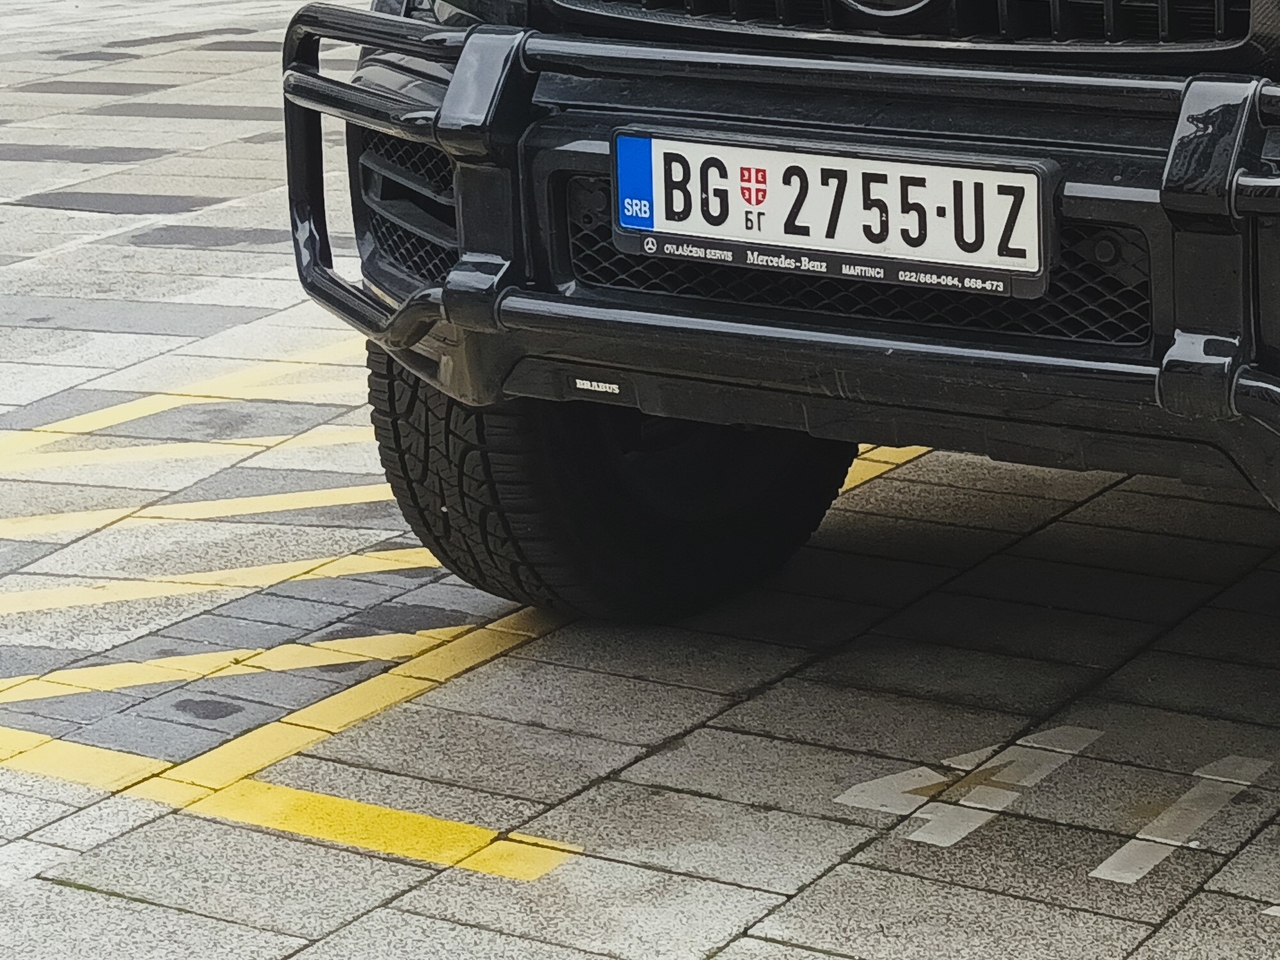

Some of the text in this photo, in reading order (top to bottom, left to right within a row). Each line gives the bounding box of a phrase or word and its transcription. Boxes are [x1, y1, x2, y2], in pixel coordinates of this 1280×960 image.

[662, 151, 730, 228] BG
[623, 198, 651, 220] SRB
[706, 249, 733, 262] SERVIS
[746, 250, 828, 273] Mercedes-Benz
[841, 263, 885, 279] MARTINCI
[575, 379, 620, 394] BRABUS
